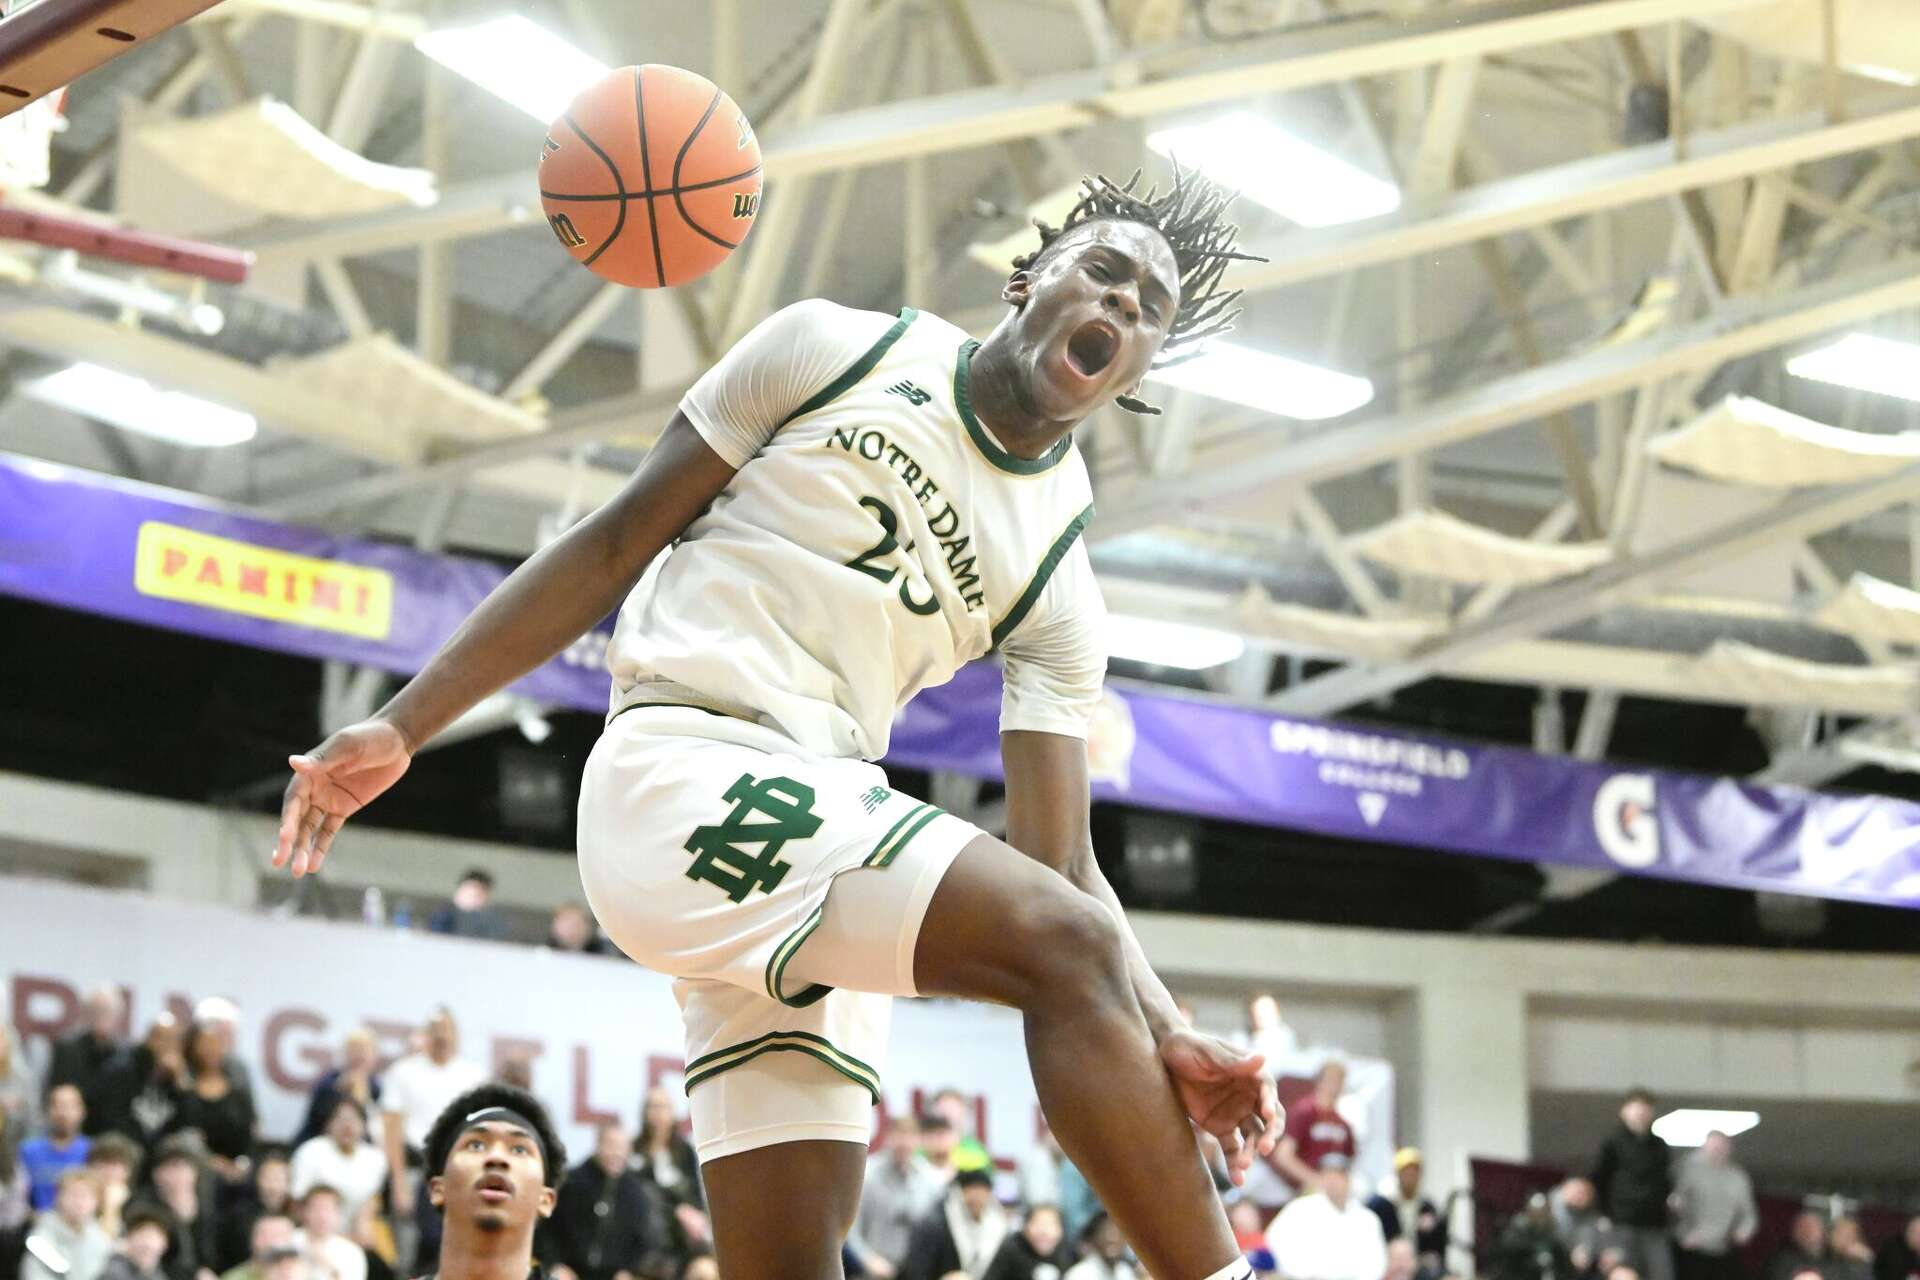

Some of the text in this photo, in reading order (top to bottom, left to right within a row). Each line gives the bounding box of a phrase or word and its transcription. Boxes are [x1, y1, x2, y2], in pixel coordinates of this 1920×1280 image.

[826, 427, 984, 613] NOTRE DAME
[162, 547, 369, 617] PANINI
[1269, 719, 1471, 781] SPRINGFIELD
[1593, 772, 1661, 869] G
